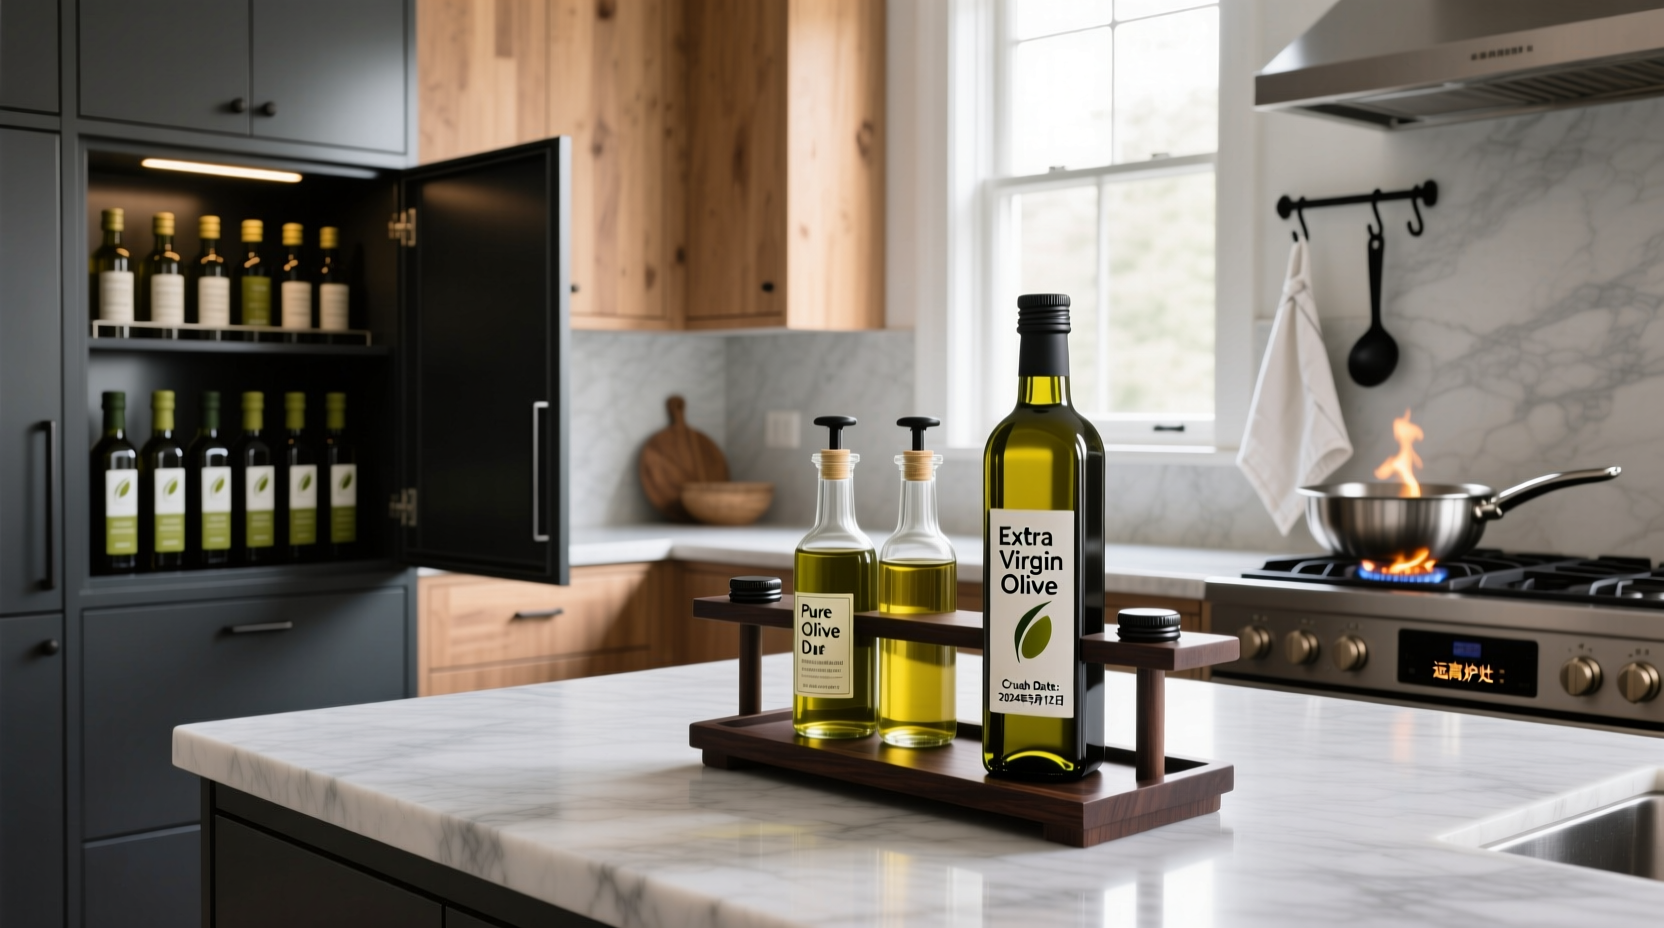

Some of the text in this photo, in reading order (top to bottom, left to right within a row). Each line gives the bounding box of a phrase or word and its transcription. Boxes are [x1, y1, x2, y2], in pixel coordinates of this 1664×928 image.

[999, 526, 1053, 546] Extra
[999, 550, 1063, 576] Virgin
[1001, 573, 1058, 595] Olive
[801, 603, 832, 619] Pure
[801, 621, 840, 639] Olive
